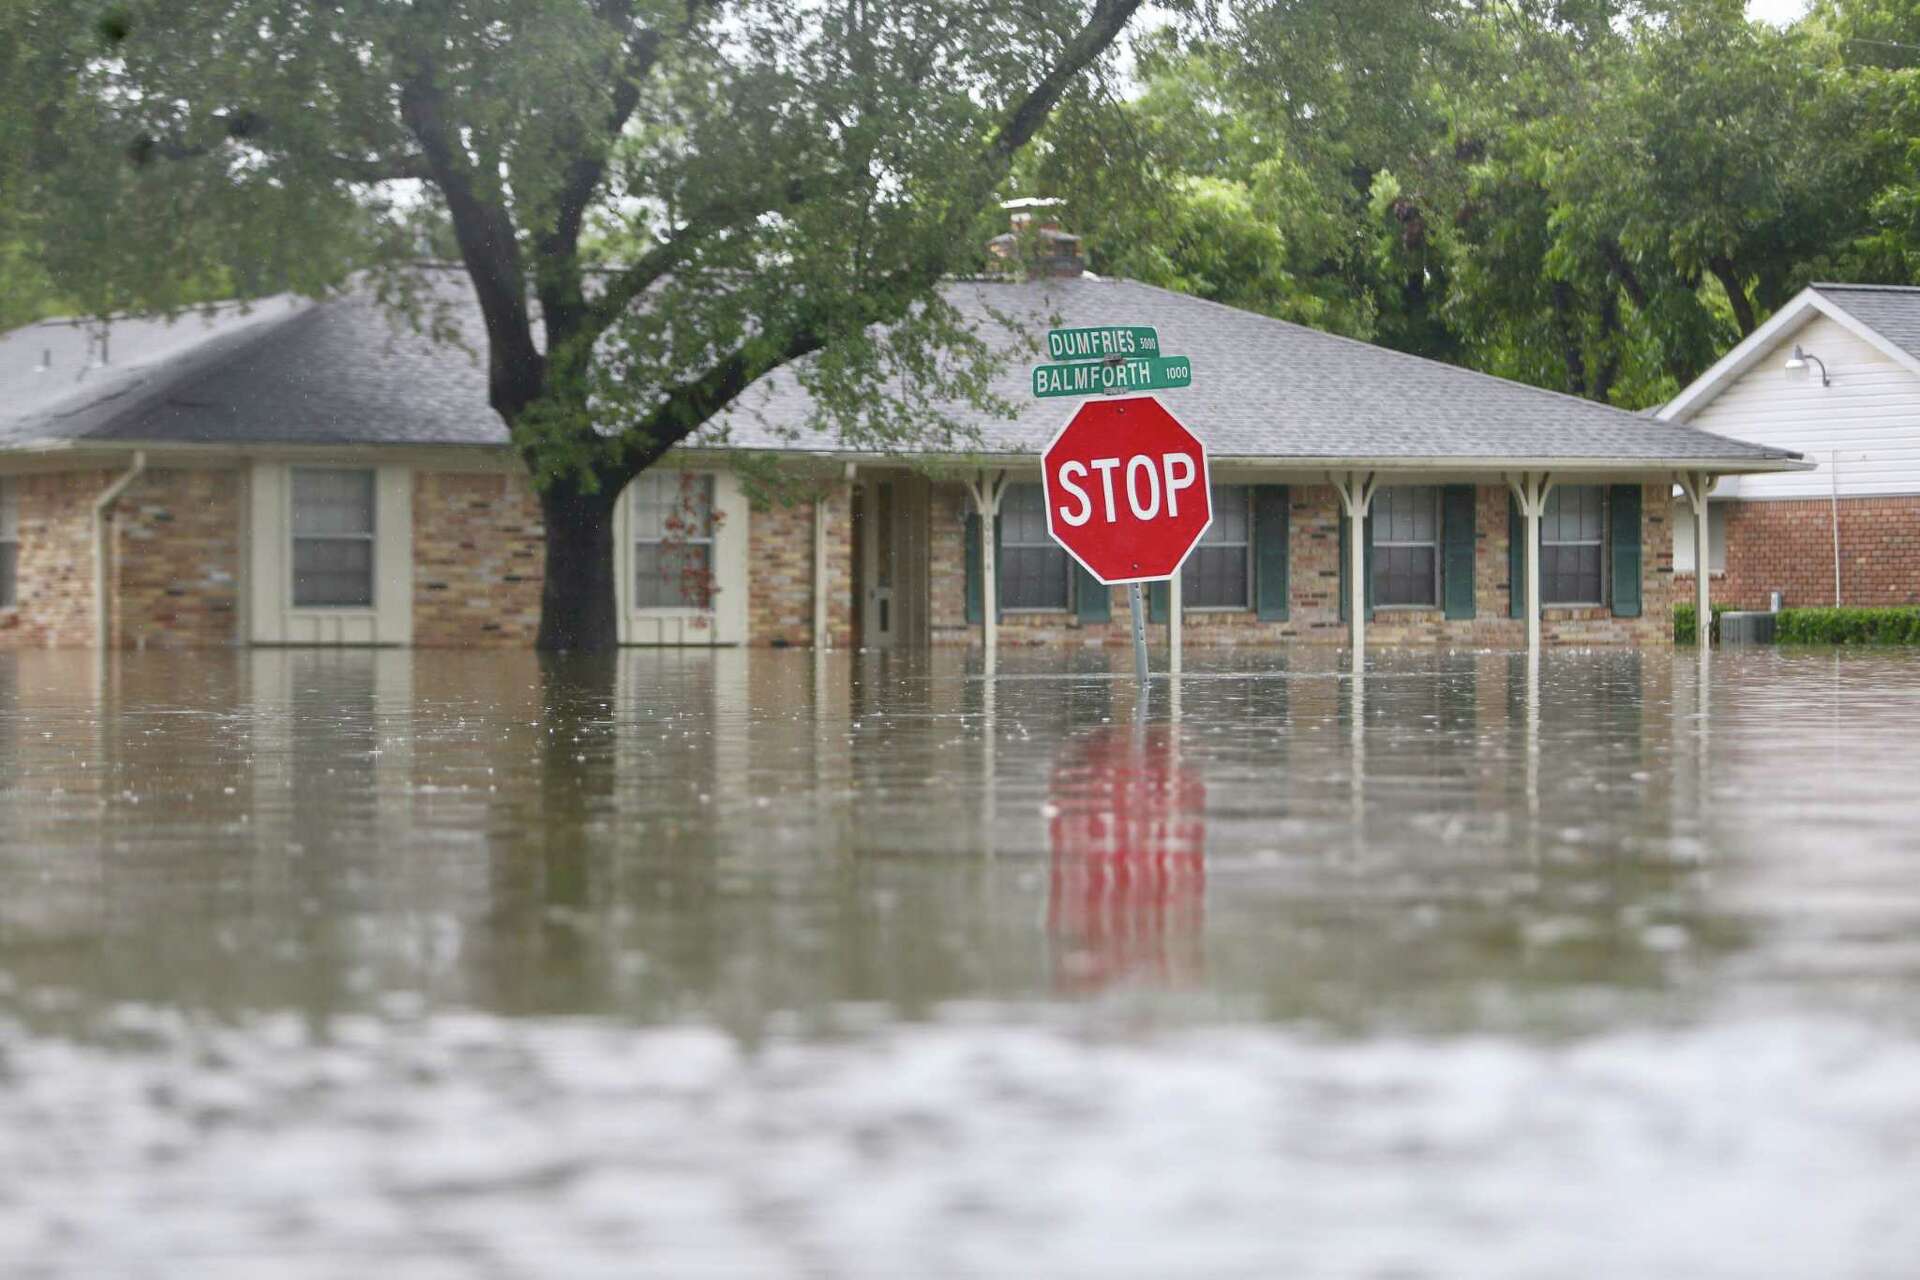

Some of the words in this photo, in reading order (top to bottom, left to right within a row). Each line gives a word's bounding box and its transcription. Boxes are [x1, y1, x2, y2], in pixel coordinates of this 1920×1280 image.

[1051, 330, 1136, 356] DUMFRIES
[1037, 361, 1151, 393] BALMFORTH
[1166, 366, 1188, 380] 1000
[1058, 452, 1196, 527] STOP
